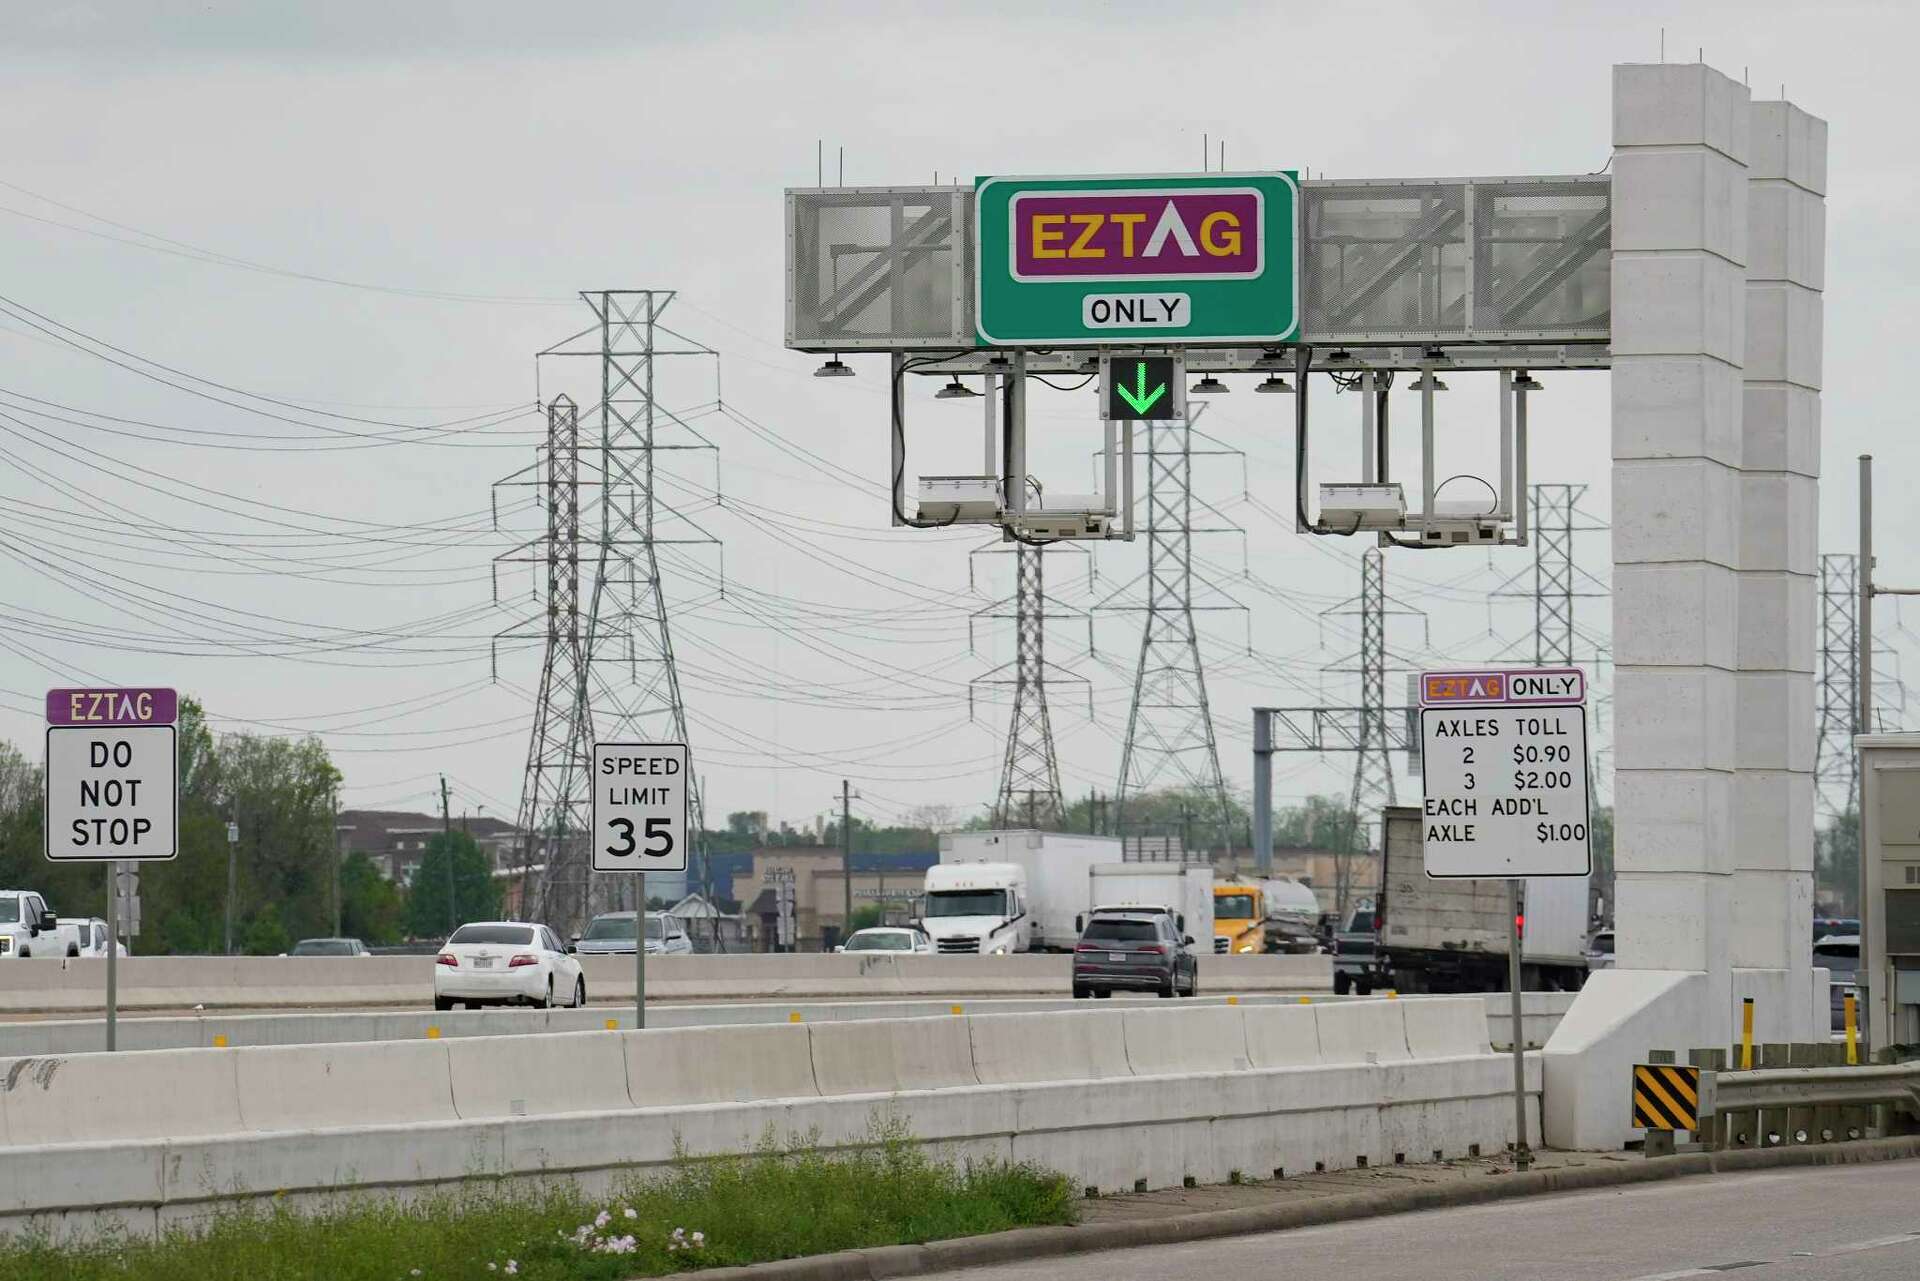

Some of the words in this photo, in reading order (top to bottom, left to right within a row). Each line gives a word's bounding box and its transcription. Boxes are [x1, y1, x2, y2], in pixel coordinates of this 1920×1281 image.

[1090, 298, 1181, 324] ONLY
[1513, 677, 1576, 696] ONLY
[1435, 718, 1500, 738] AXLES
[1515, 717, 1568, 736] TOLL
[90, 740, 132, 768] DO
[1462, 746, 1475, 764] 2
[1513, 743, 1571, 765] $0.90
[602, 757, 680, 775] SPEED
[1464, 772, 1476, 790] 3
[1514, 769, 1572, 791] $2.00
[80, 779, 142, 808] NOT
[610, 787, 670, 806] LIMIT
[1425, 798, 1477, 816] EACH
[1491, 797, 1549, 816] ADD'L
[71, 818, 152, 846] STOP
[606, 817, 674, 858] 35
[1427, 824, 1476, 843] AXLE
[1537, 821, 1586, 844] $1.00
